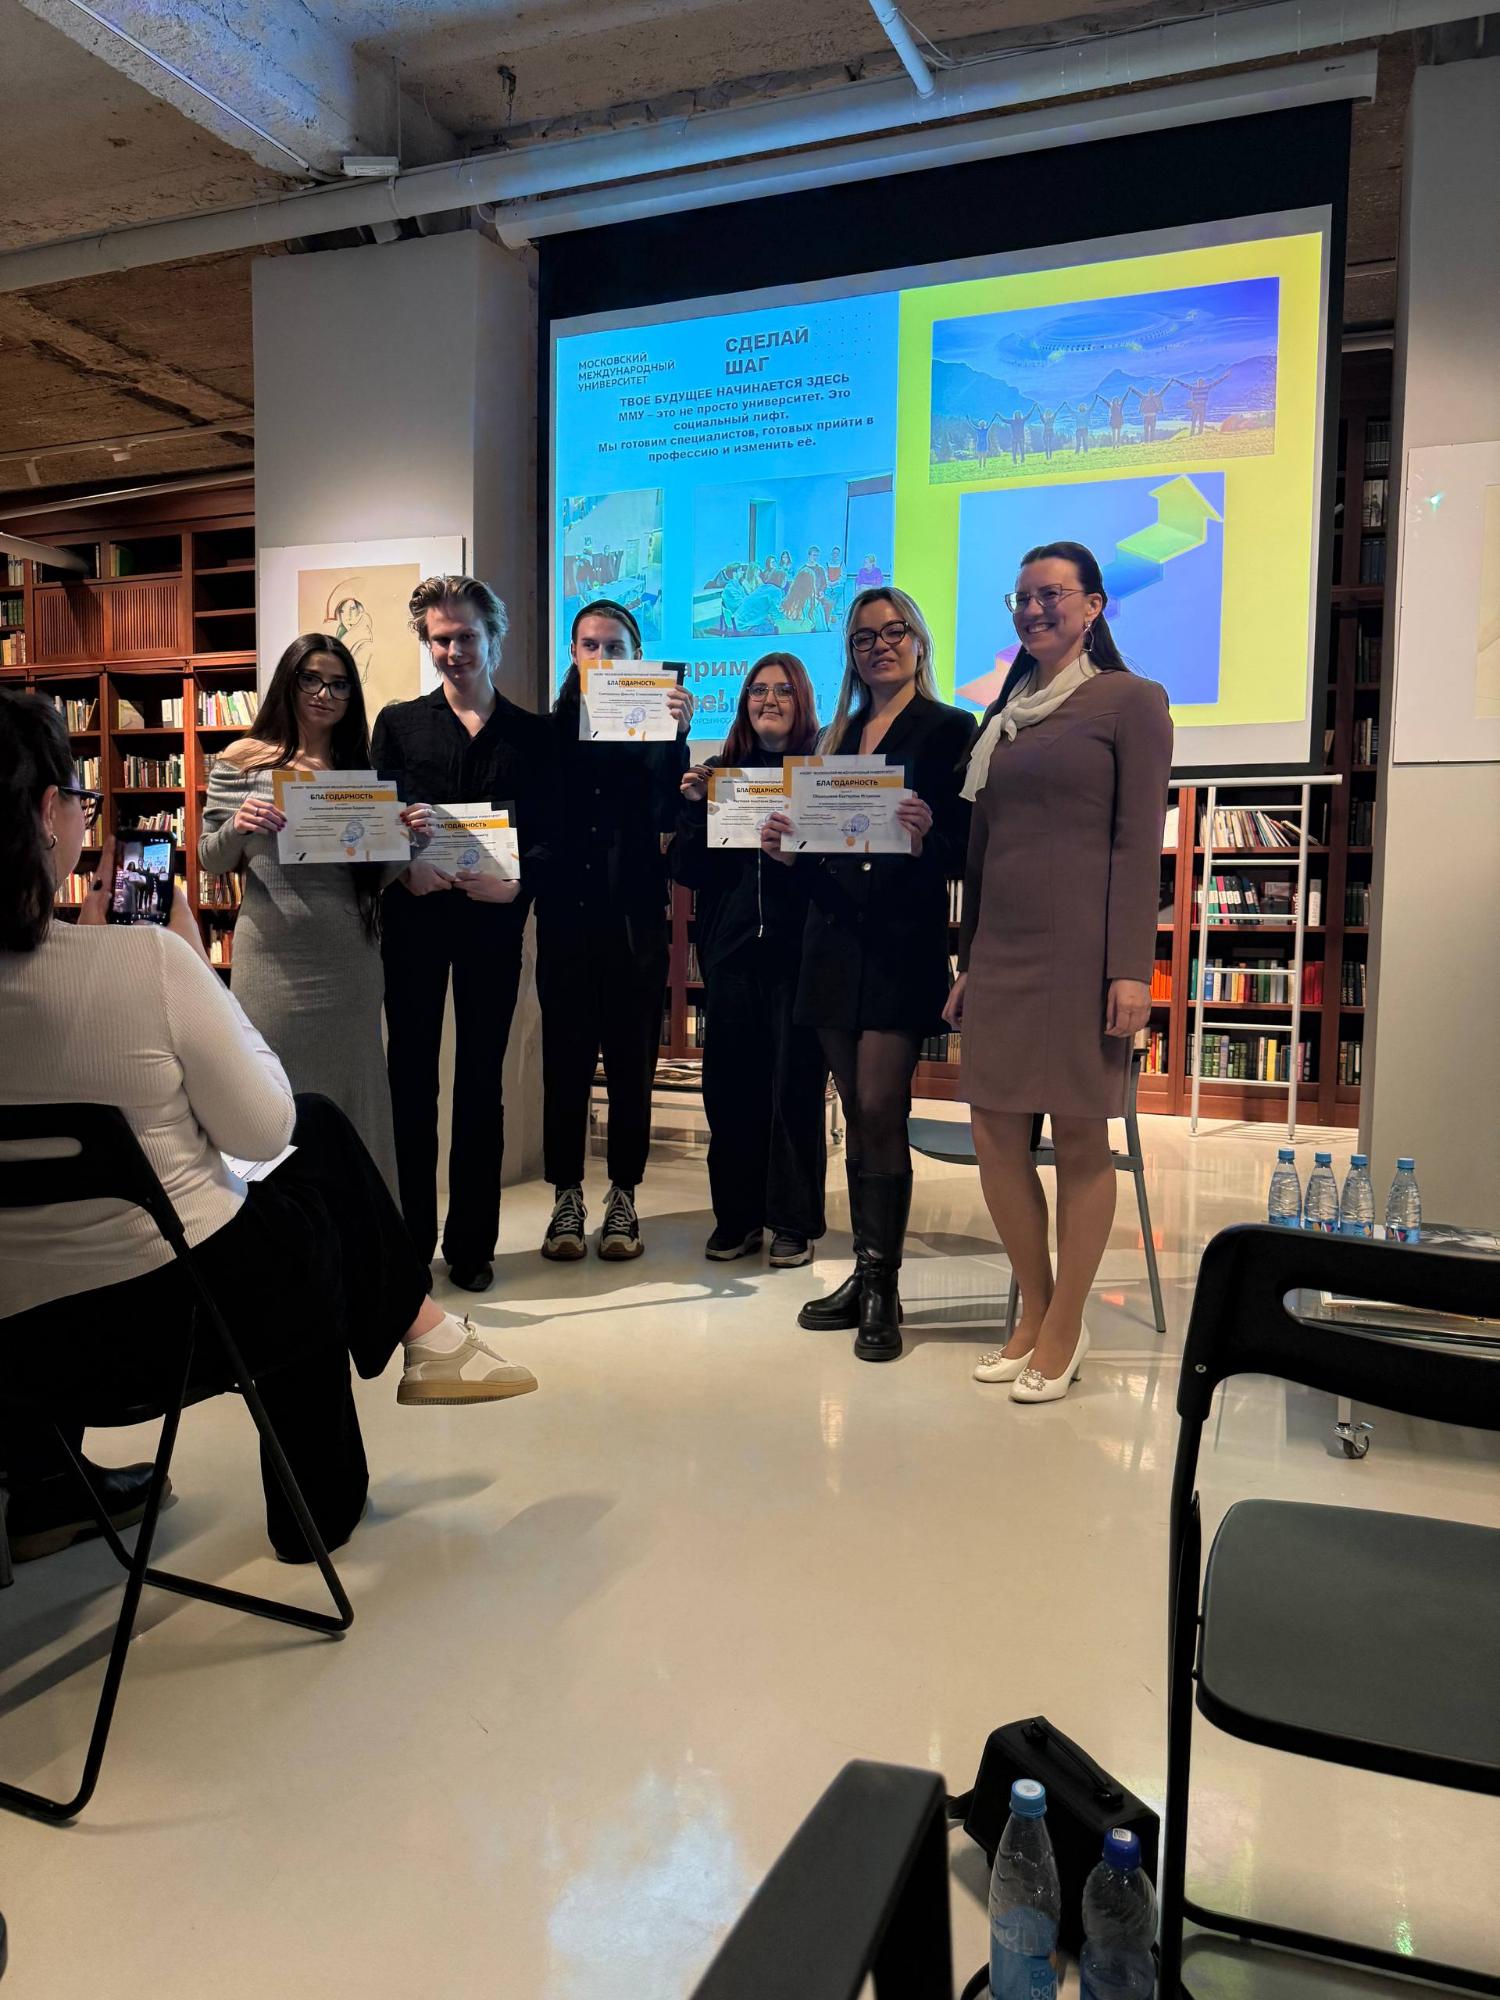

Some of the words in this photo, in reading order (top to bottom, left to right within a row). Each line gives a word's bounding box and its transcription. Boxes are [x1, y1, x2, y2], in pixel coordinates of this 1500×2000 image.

[726, 325, 808, 353] СДЕЛАЙ
[579, 352, 647, 369] МОСКОВСКИЙ
[579, 360, 675, 380] МЕЖДУНАРОДНЫЙ
[726, 356, 769, 375] ШАГ
[578, 376, 648, 391] УНИВЕРСИТЕТ
[655, 388, 712, 404] БУДУЩЕЕ
[717, 378, 803, 396] НАЧИНАЕТСЯ
[807, 373, 850, 388] ЗДЕСЬ
[619, 410, 645, 422] ММУ
[656, 409, 676, 418] это
[680, 406, 694, 416] не
[697, 401, 738, 415] просто
[742, 392, 825, 411] университет.
[828, 388, 851, 400] Это
[673, 412, 749, 431] социальный
[753, 410, 789, 422] лифт.
[598, 442, 617, 453] Мы
[621, 438, 667, 450] готовим
[670, 428, 759, 446] специалистов,
[762, 422, 813, 437] готовых
[817, 416, 862, 431] прийти
[866, 416, 874, 425] в
[648, 447, 719, 463] профессию
[723, 446, 730, 455] и
[734, 438, 794, 454] изменить
[816, 779, 879, 787] БЛАГОДАРНОСТЬ
